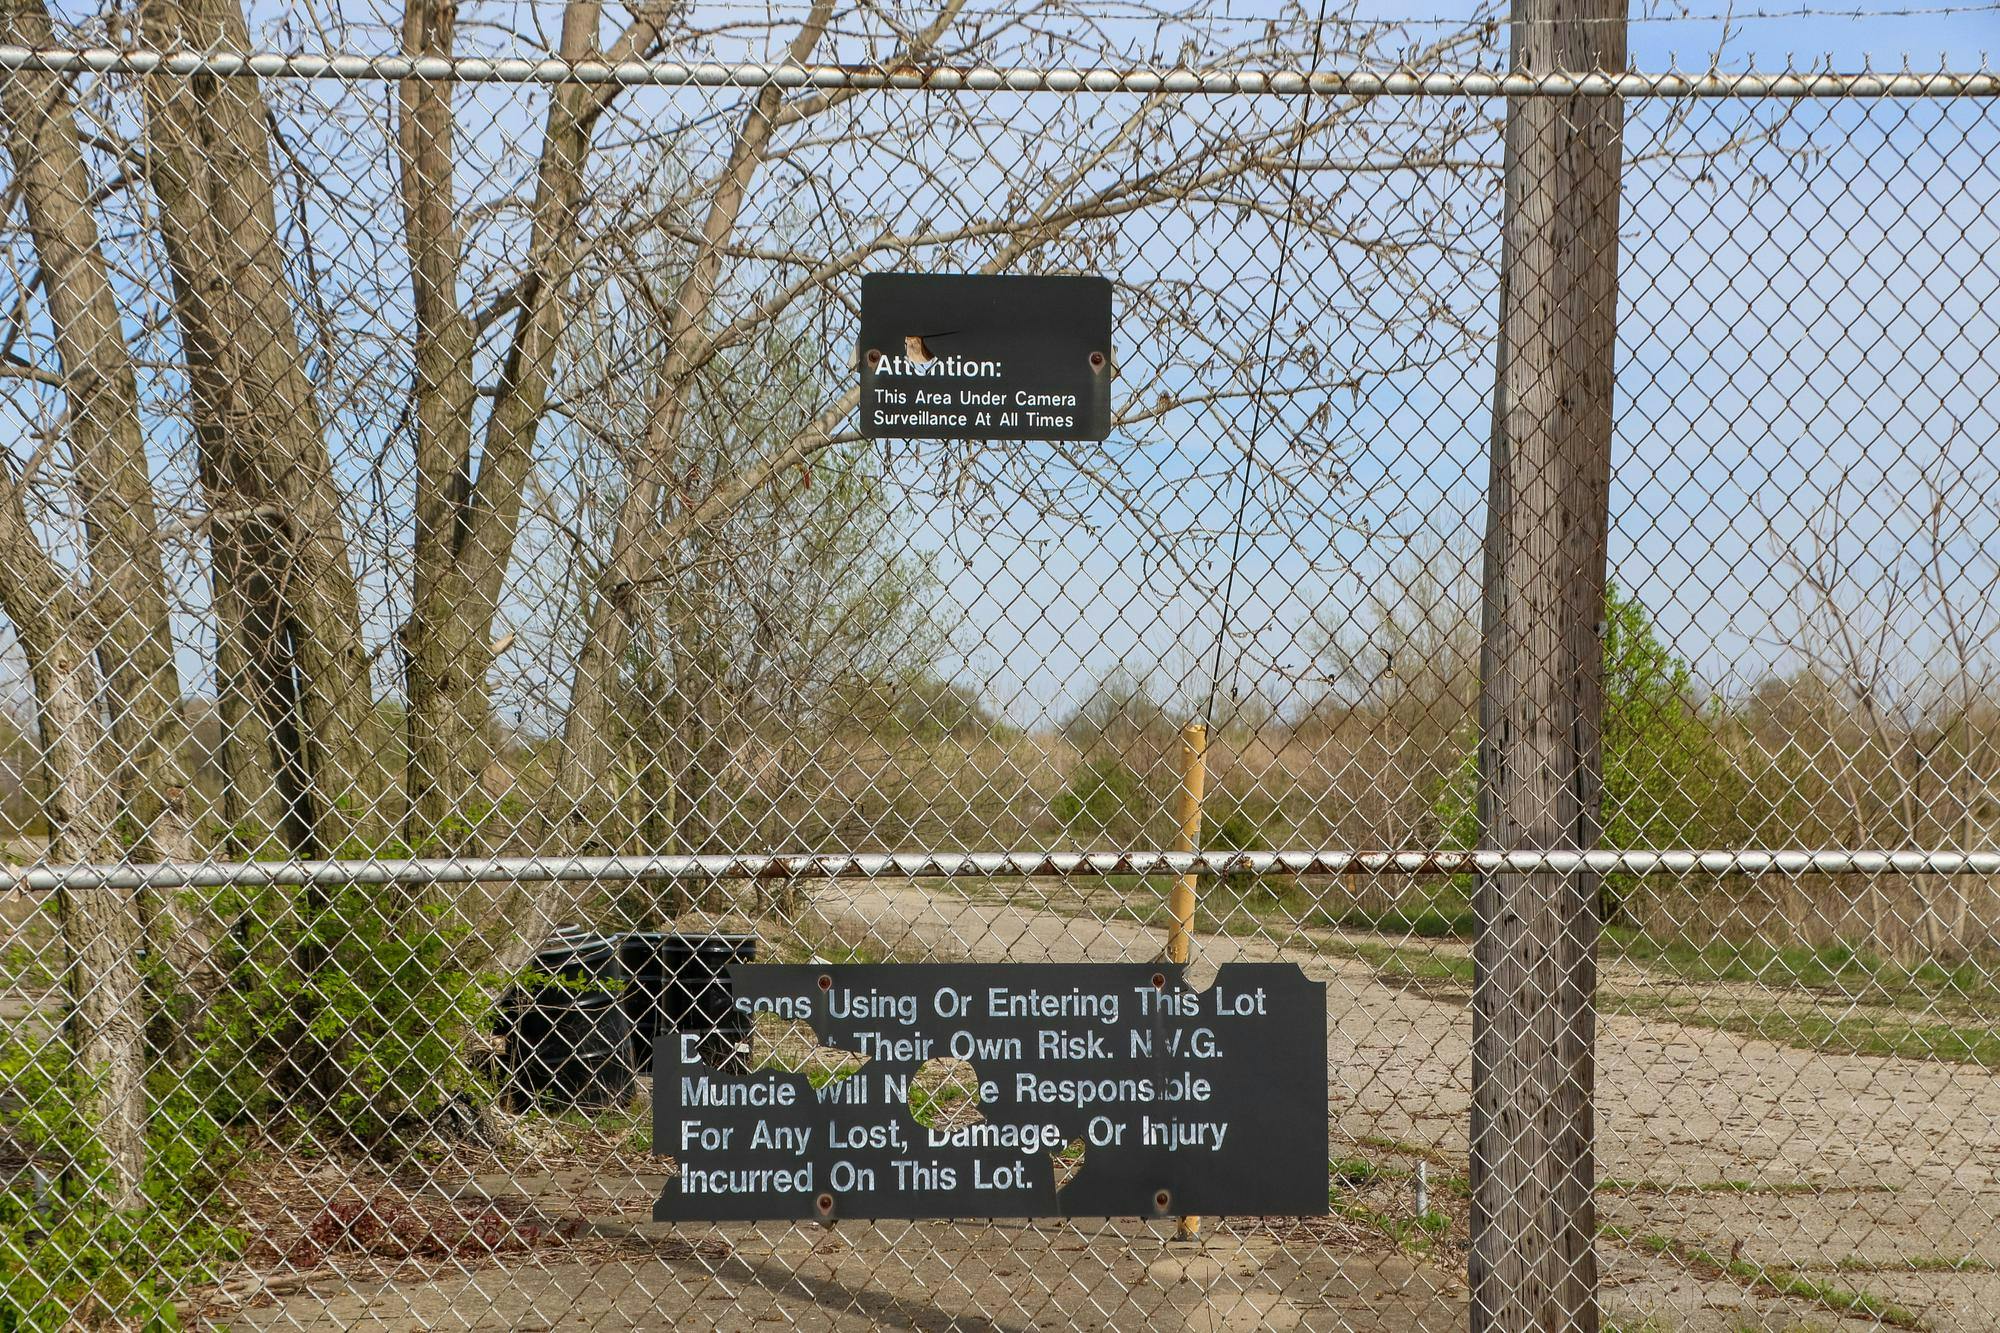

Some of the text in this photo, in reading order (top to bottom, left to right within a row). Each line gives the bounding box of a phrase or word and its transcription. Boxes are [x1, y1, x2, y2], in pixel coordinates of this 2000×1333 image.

[875, 389, 1076, 406] This Area Under Camera
[874, 411, 1073, 427] Surveillance At All Times
[829, 989, 917, 1024] Using
[933, 987, 972, 1017] Or
[989, 988, 1118, 1024] Entering
[1134, 987, 1200, 1016] This
[1217, 987, 1267, 1016] Lot
[853, 1032, 934, 1062] Their
[950, 1030, 1022, 1062] Own
[1039, 1030, 1114, 1060] Risk.
[681, 1076, 796, 1106] Muncie
[1016, 1072, 1211, 1108] Responsble
[681, 1115, 1228, 1155] For Any Lost, Damage, Or Injury
[681, 1160, 1032, 1194] Incurred On This Lot.
